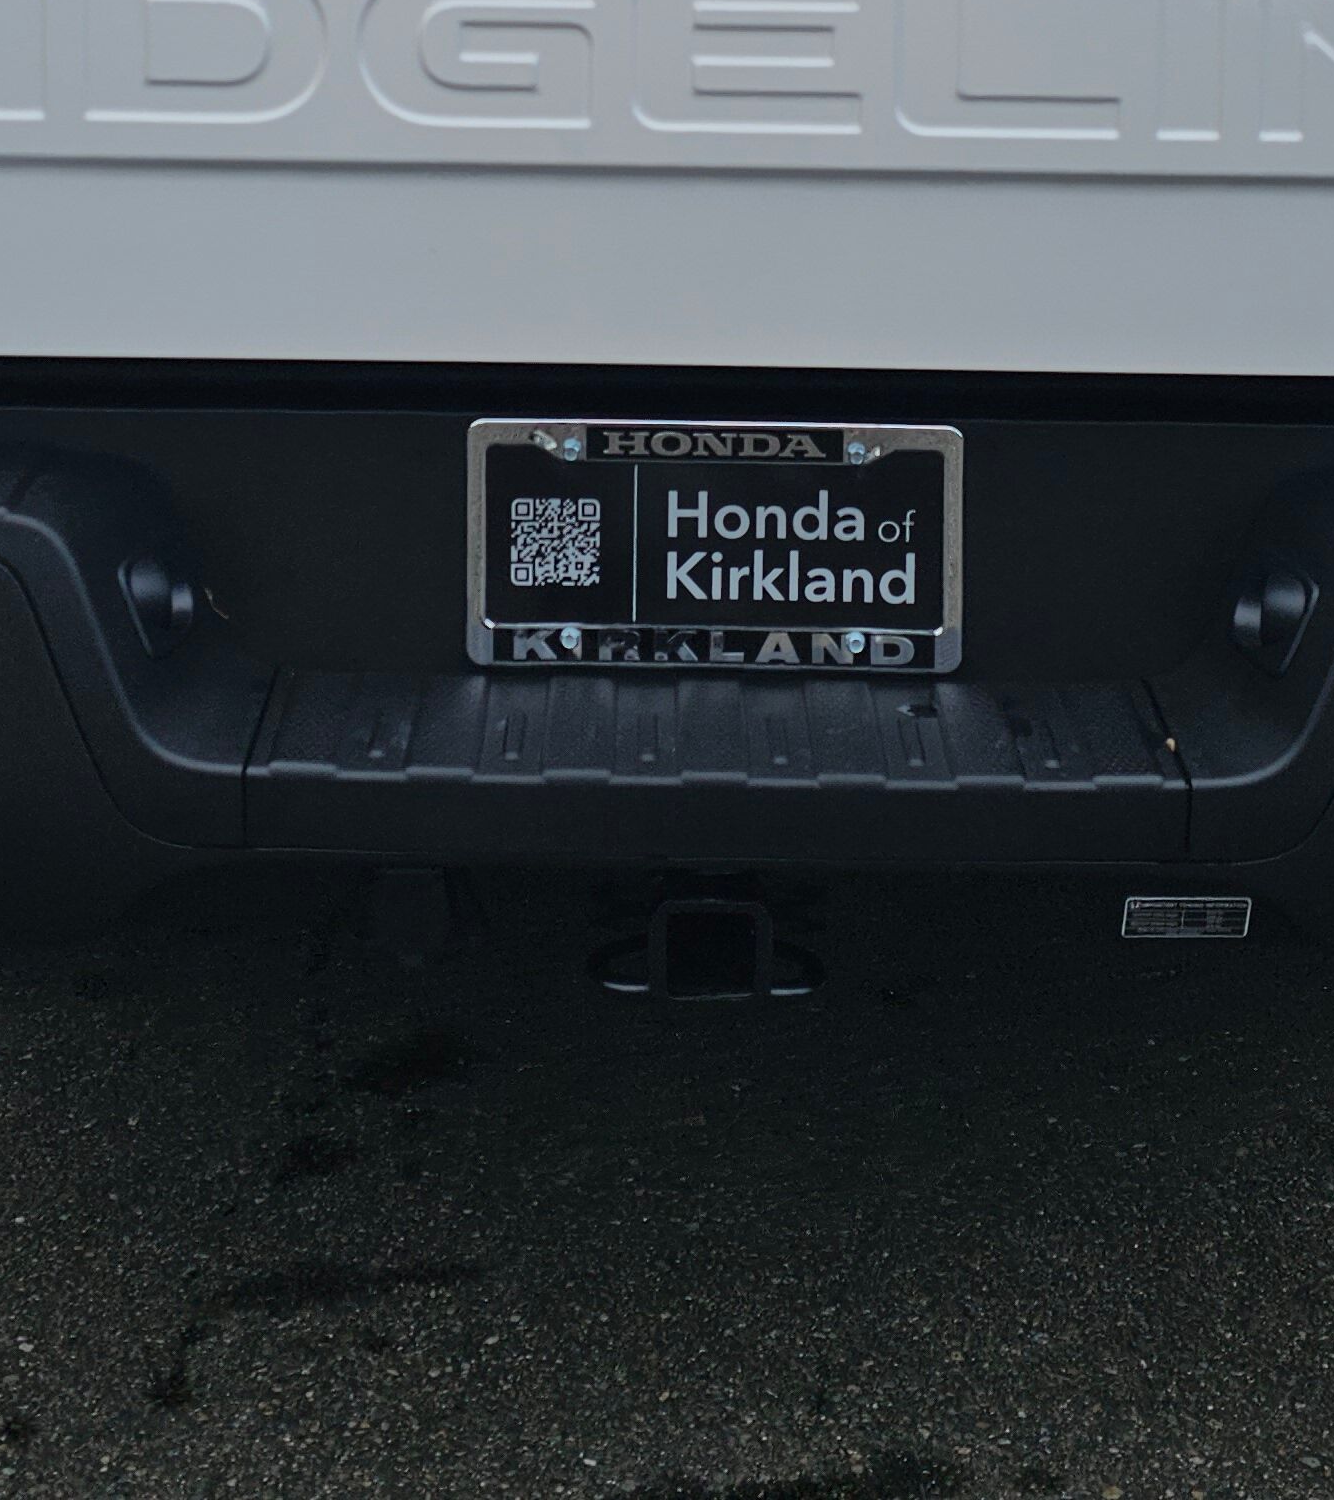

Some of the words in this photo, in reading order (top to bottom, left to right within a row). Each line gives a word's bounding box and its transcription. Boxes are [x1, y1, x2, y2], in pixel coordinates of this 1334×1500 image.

[602, 431, 826, 459] HONDA
[667, 489, 865, 541] Honda
[877, 509, 916, 543] of
[667, 549, 916, 605] Kirkland
